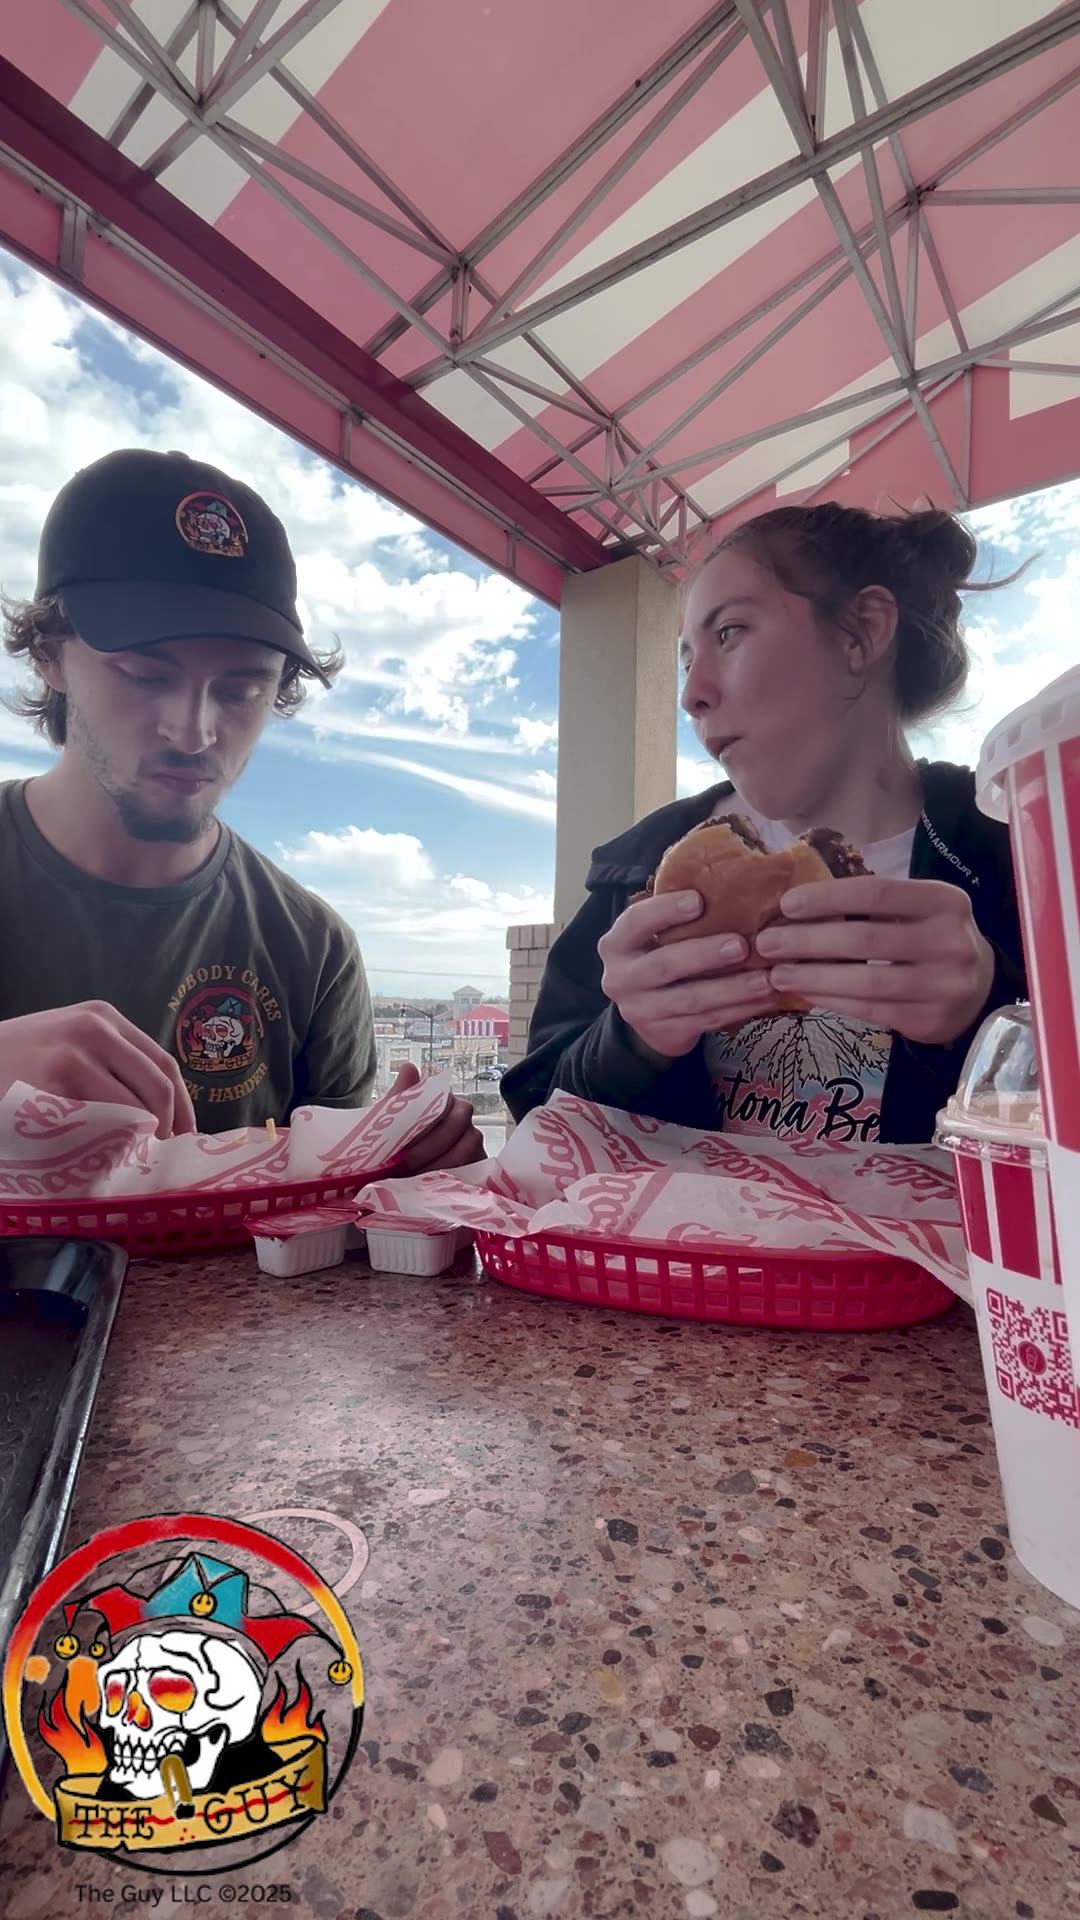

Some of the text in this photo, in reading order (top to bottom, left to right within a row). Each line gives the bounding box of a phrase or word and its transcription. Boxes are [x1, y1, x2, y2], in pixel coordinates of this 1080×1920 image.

[932, 838, 972, 877] ARMOUR
[168, 964, 281, 1022] NOBODY CARES
[208, 1062, 268, 1102] HARDER
